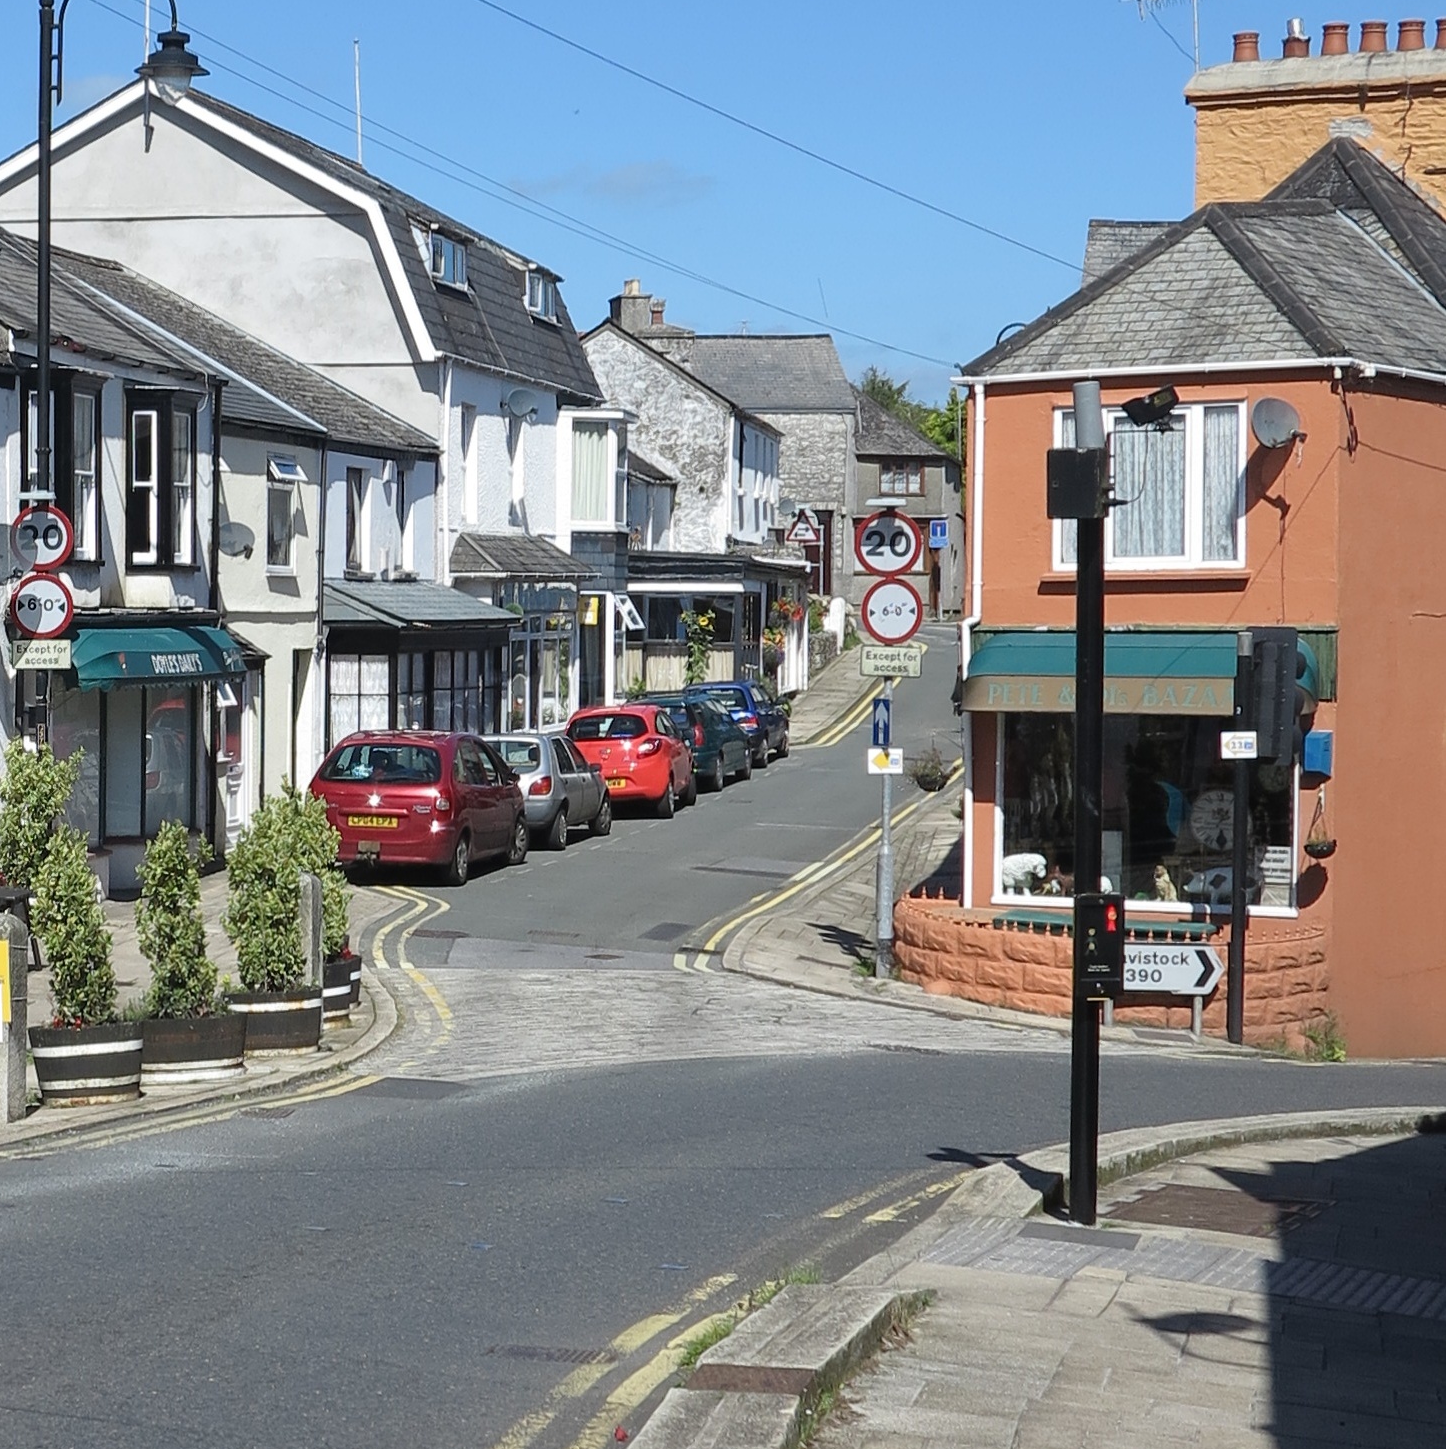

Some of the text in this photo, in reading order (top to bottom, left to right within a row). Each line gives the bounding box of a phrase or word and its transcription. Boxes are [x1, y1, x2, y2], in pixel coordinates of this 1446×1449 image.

[20, 524, 63, 551] 20
[865, 530, 911, 557] 20
[16, 644, 68, 658] Except for
[865, 649, 918, 663] Except for
[24, 657, 58, 665] access
[873, 663, 909, 673] access
[987, 682, 1043, 706] PETE
[1058, 682, 1075, 706] &
[1125, 969, 1162, 983] 390
